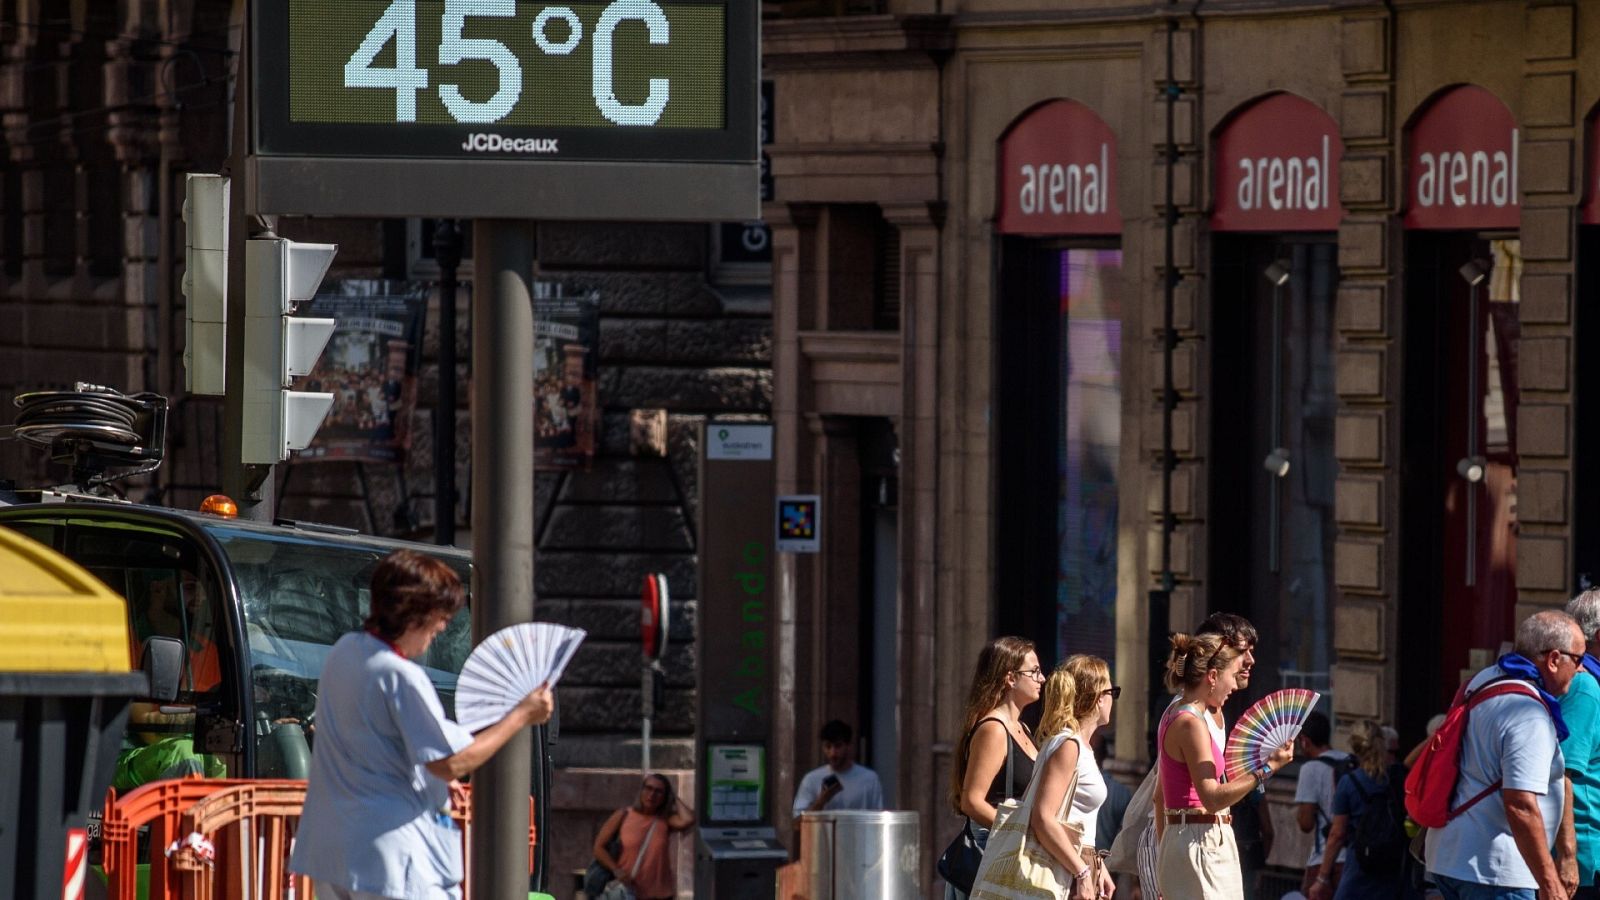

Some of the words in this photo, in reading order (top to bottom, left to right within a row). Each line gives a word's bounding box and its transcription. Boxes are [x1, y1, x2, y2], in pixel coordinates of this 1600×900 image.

[345, 0, 669, 126] 45°C
[462, 133, 558, 153] JCDecaux
[1020, 142, 1110, 216] arenal
[1237, 134, 1330, 211] arenal
[1417, 128, 1519, 207] arenal
[733, 541, 767, 716] Abando
